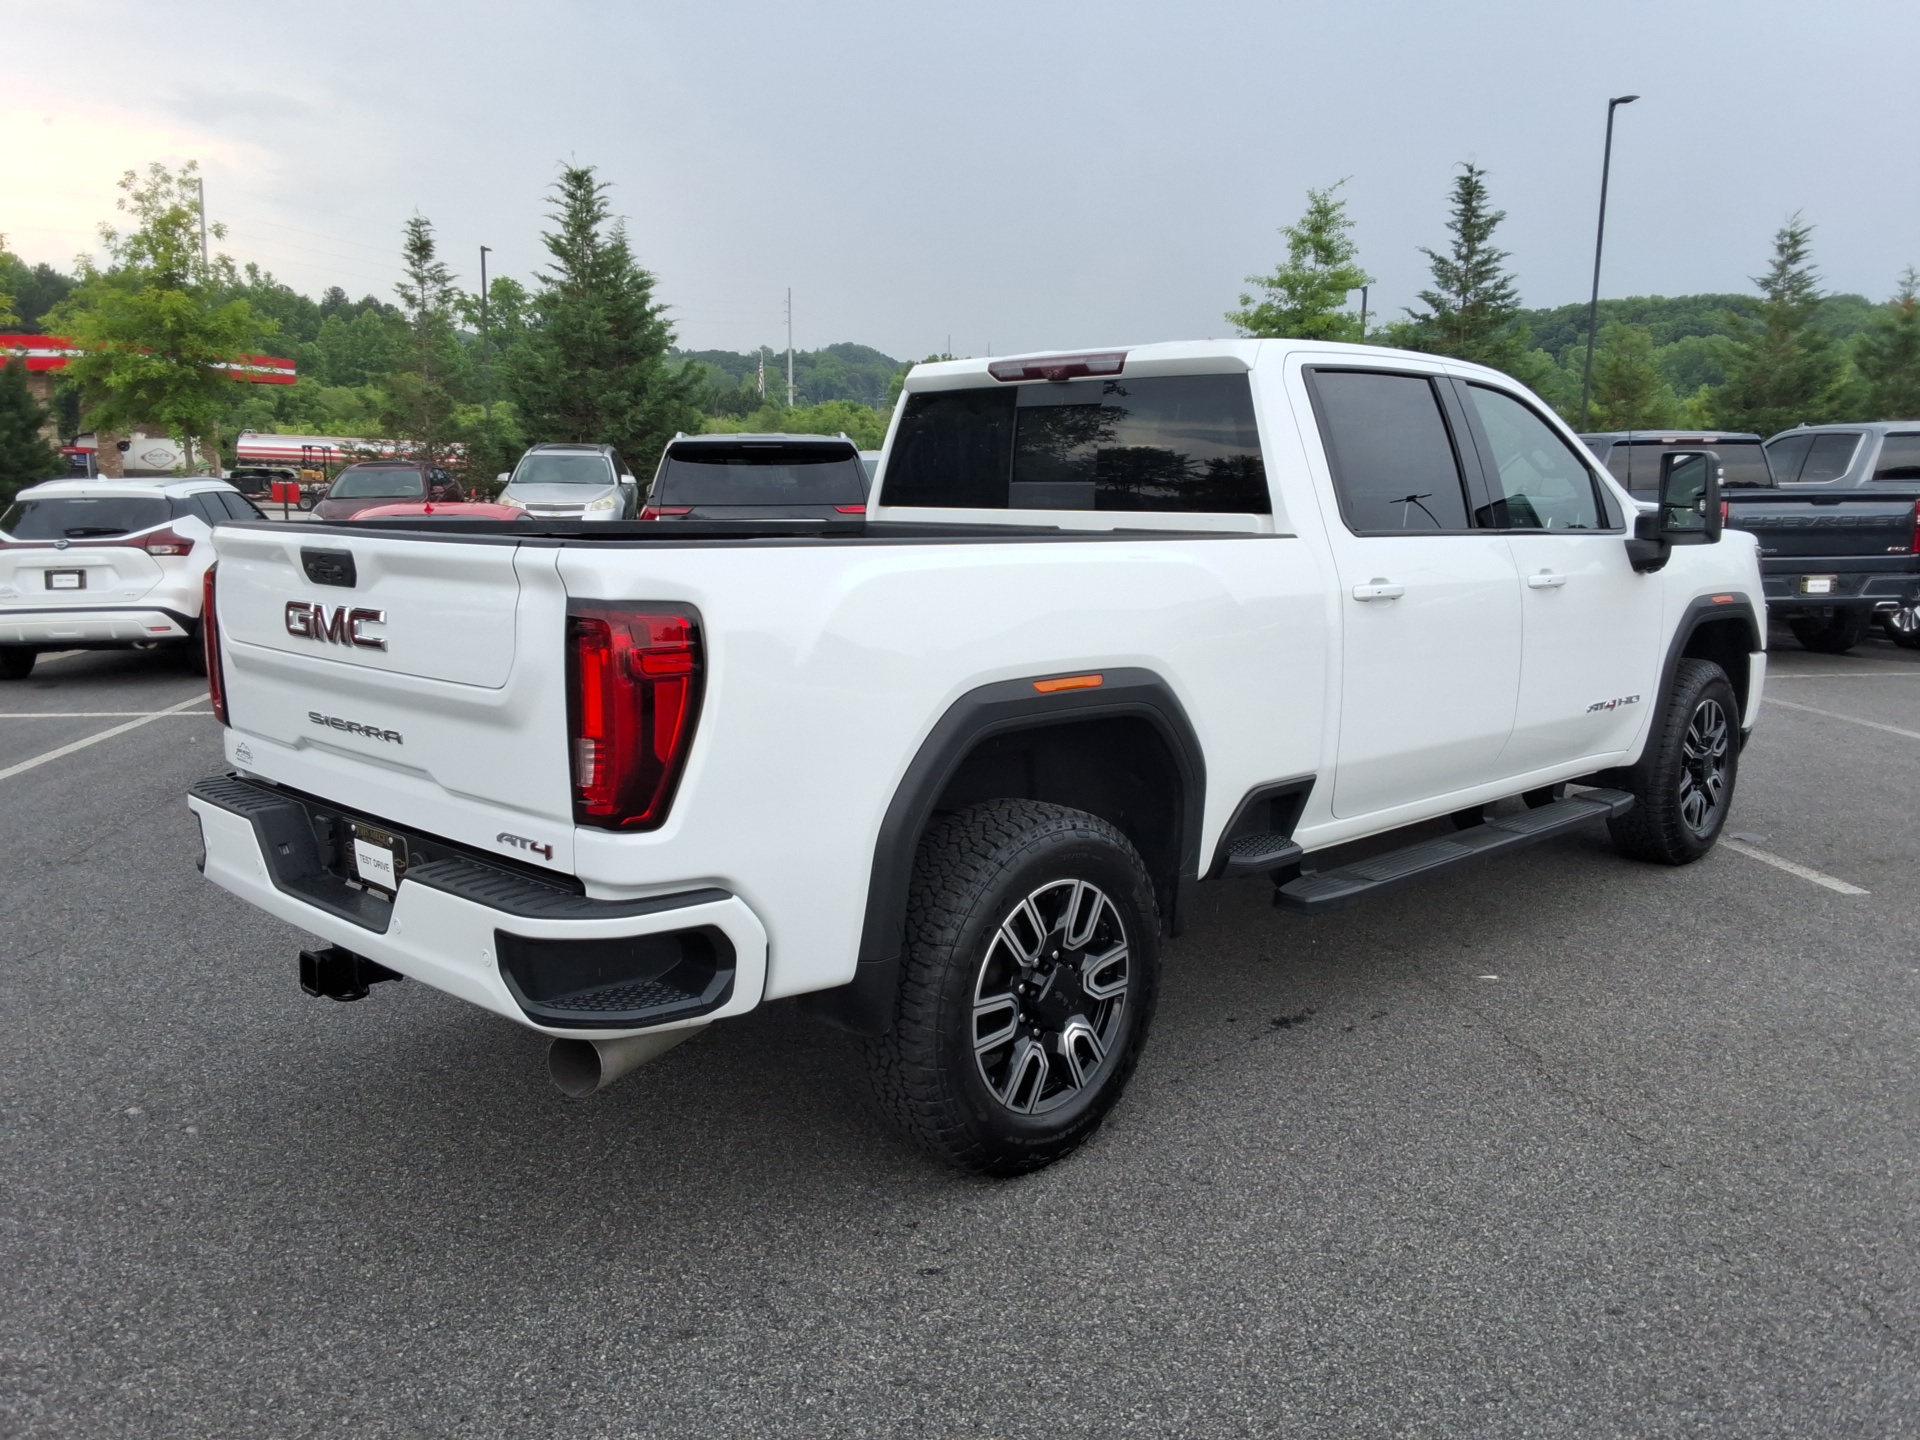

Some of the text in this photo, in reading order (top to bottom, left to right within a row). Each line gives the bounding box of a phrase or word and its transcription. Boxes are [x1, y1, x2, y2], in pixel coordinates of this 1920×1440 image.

[1742, 515, 1906, 528] CHEVROLET
[285, 600, 388, 653] GMC
[1586, 694, 1640, 713] AT4 HD
[308, 711, 403, 745] SIERRA
[496, 832, 553, 861] AT4
[359, 853, 372, 866] TEST
[373, 858, 390, 873] DRIVE
